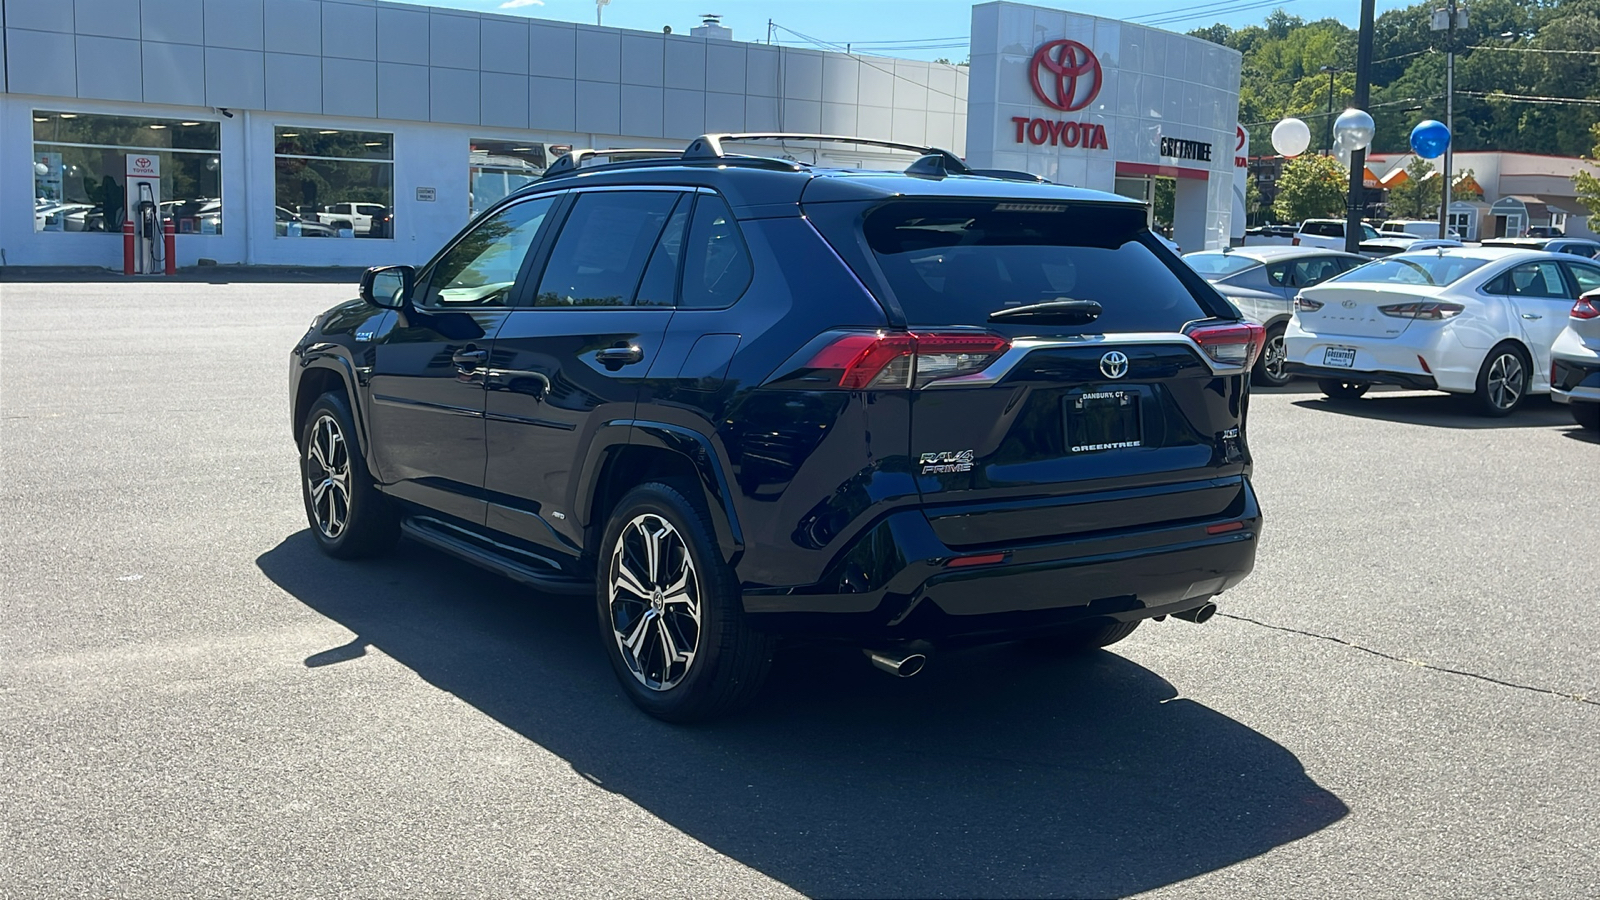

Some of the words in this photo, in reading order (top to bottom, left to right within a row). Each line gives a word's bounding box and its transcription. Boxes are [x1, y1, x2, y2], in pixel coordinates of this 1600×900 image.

[1012, 117, 1108, 150] TOYOTA
[1160, 137, 1212, 162] GREENTREE
[1327, 350, 1354, 360] GREENTREE
[1071, 440, 1141, 452] GREENTREE
[919, 449, 974, 464] RAV4
[921, 463, 973, 474] PRIME
